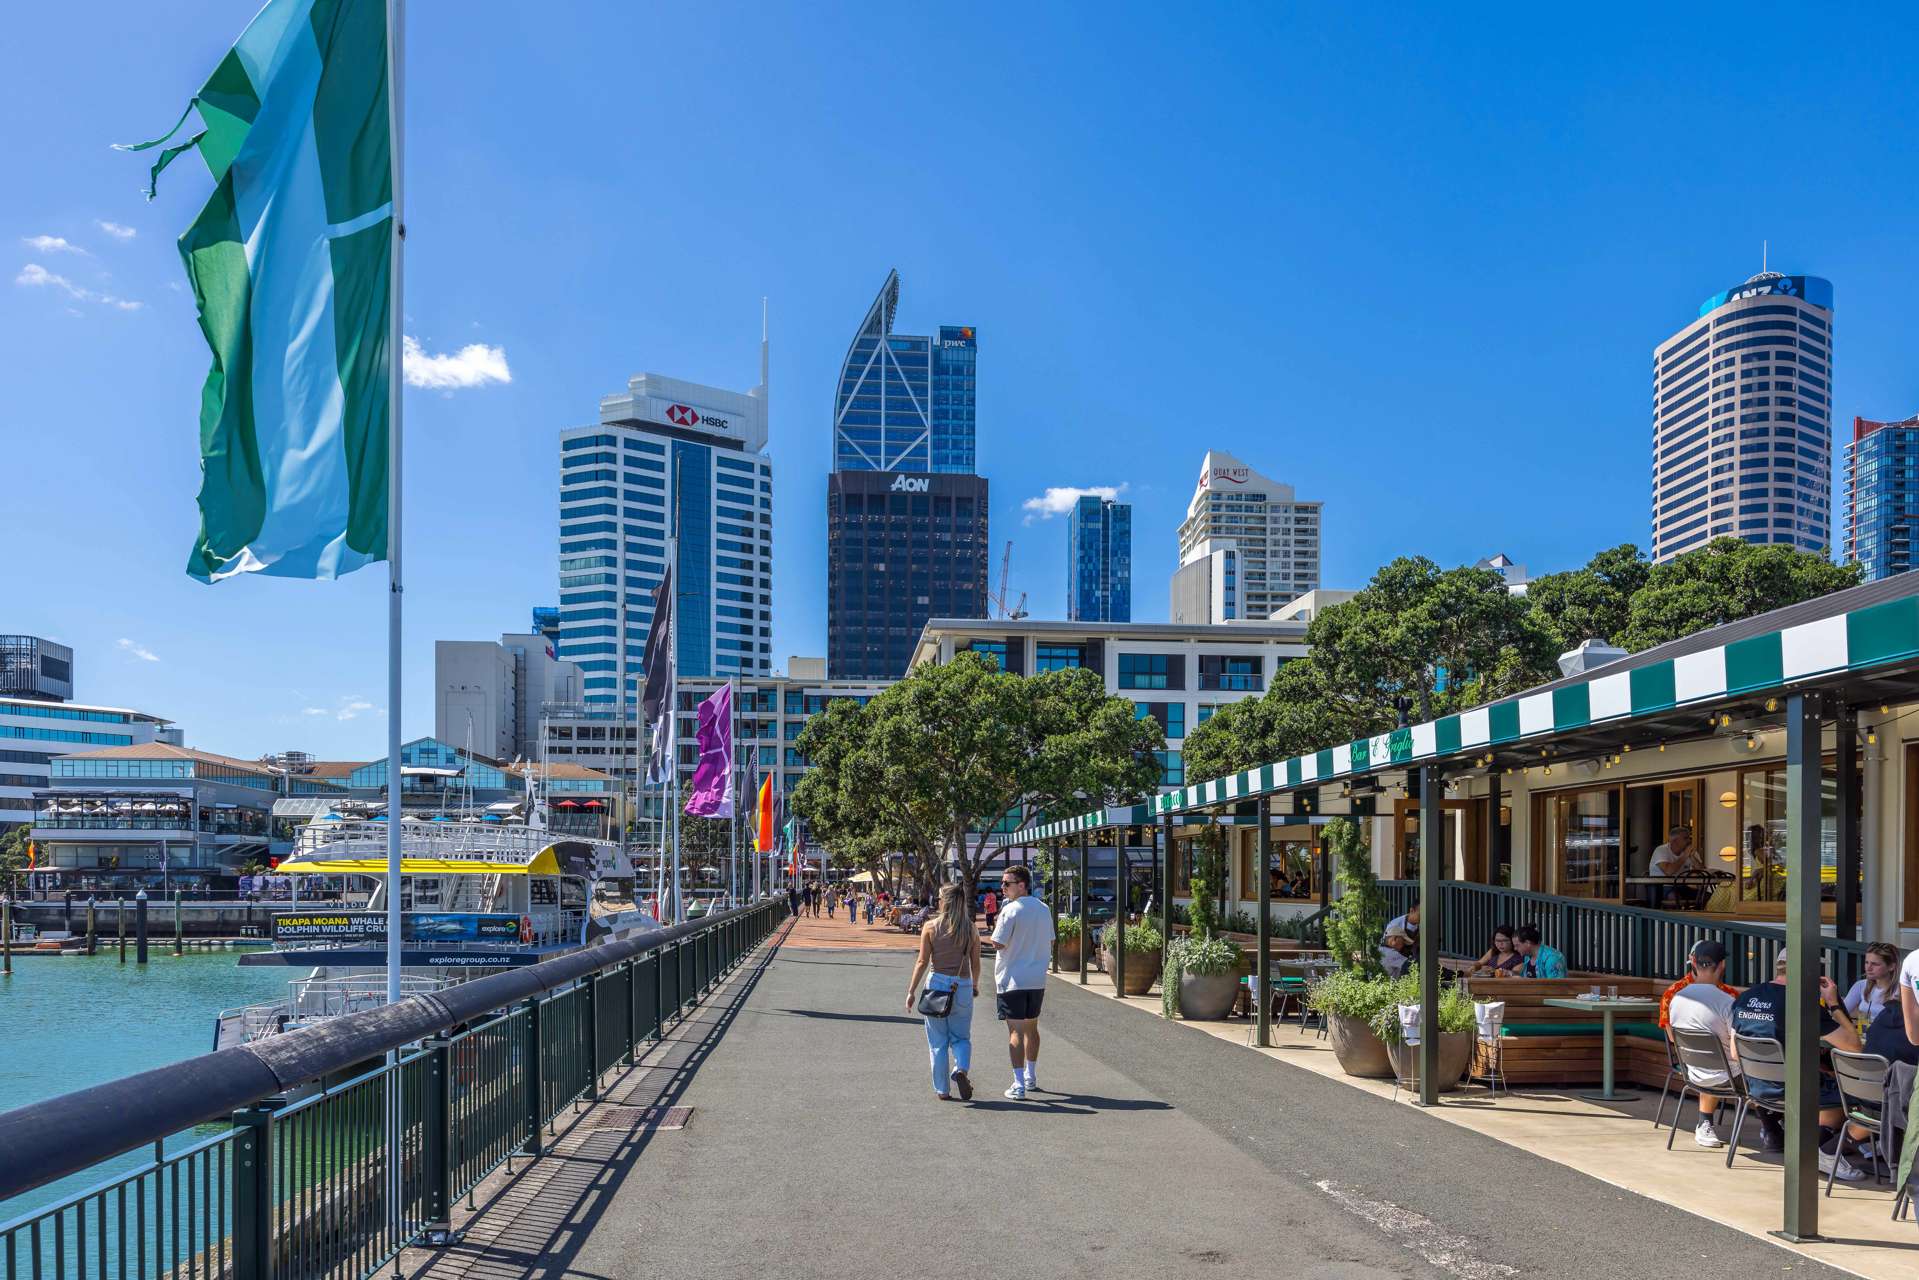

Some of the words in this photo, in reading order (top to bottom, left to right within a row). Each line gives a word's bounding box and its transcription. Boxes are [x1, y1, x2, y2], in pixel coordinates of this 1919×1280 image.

[944, 339, 966, 348] pwc
[701, 415, 729, 429] HSBC
[1232, 467, 1249, 477] WEST
[1350, 743, 1368, 762] Bar
[277, 918, 311, 926] TIKAPA
[313, 917, 349, 925] MOANA
[350, 917, 385, 925] WHALE
[277, 926, 320, 934] DOLPHIN
[321, 925, 365, 933] WILDLIFE
[481, 925, 506, 933] explore
[429, 956, 511, 964] exploregroup.co.nz
[1747, 997, 1772, 1009] Beers
[1738, 1011, 1775, 1022] ENGINEERS
